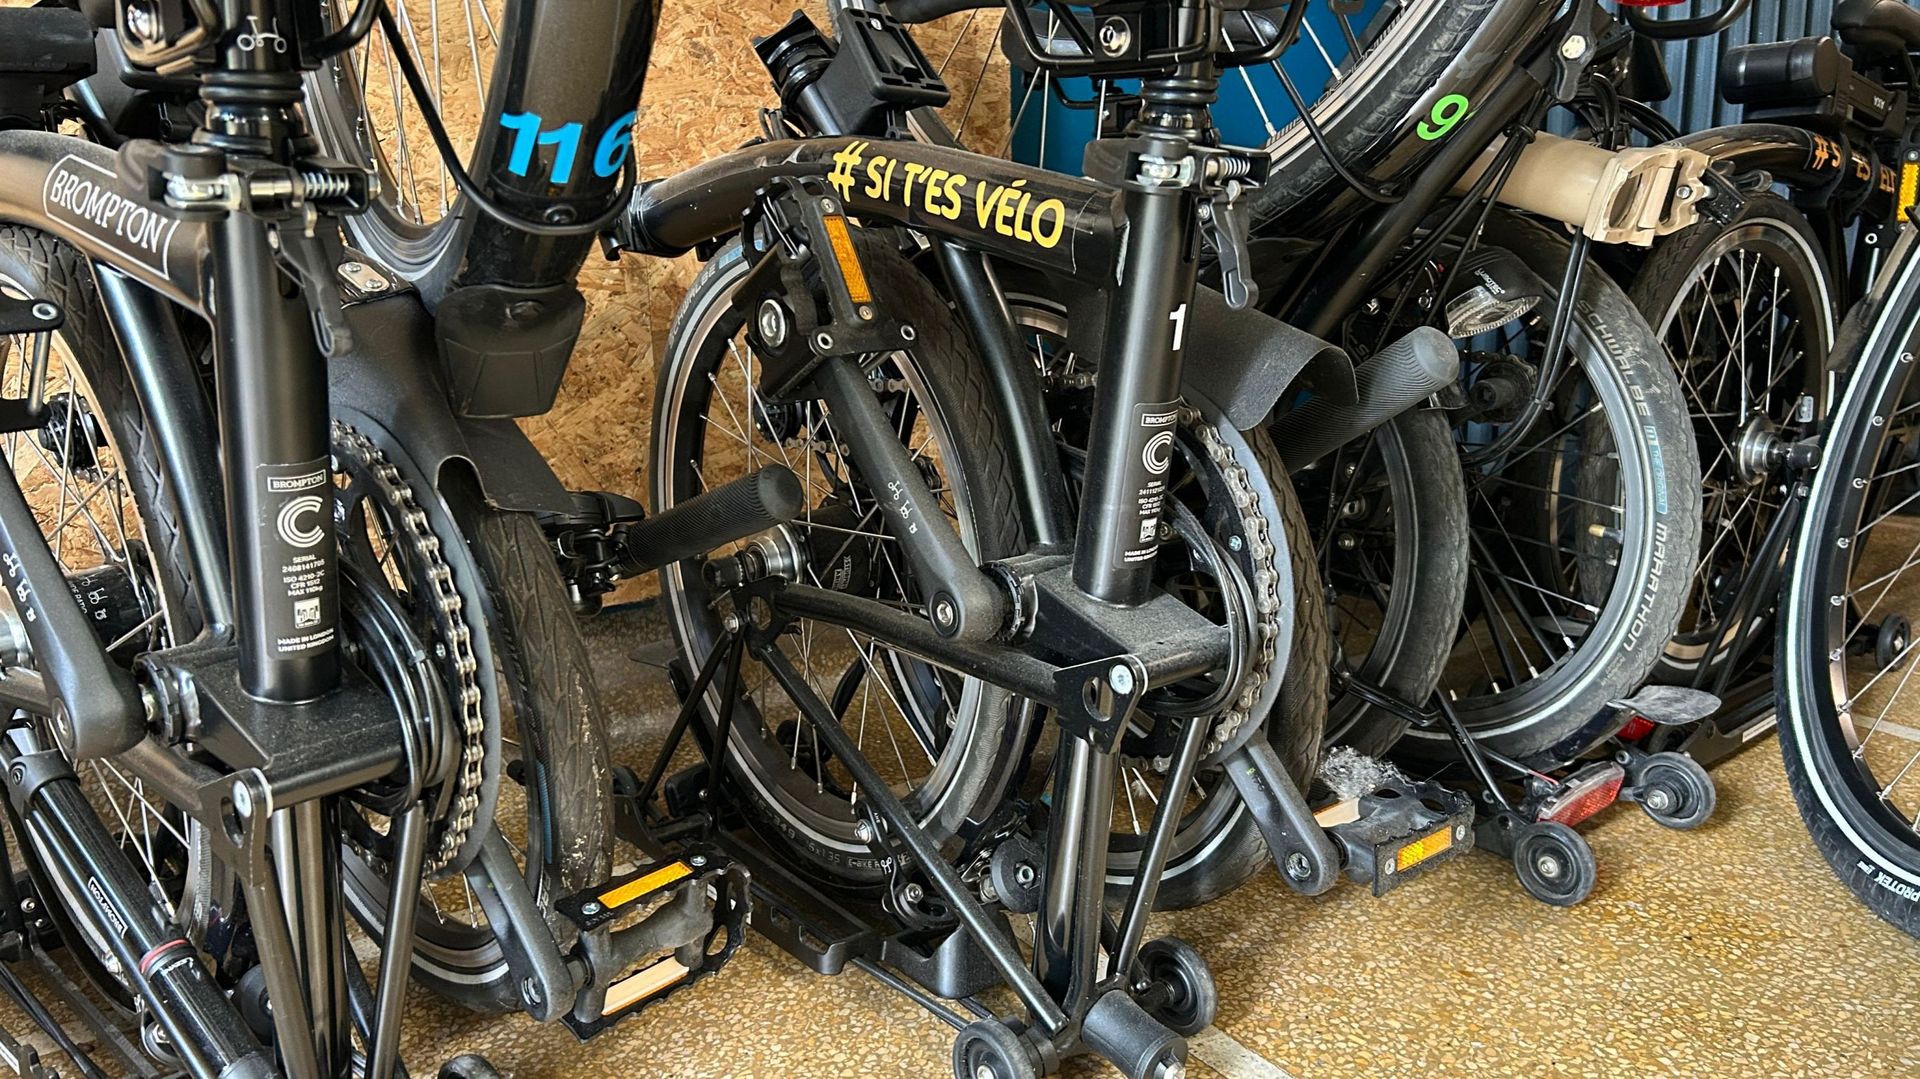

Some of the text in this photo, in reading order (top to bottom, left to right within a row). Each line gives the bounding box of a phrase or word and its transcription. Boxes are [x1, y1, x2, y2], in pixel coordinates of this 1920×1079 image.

[1417, 94, 1469, 140] 9
[500, 111, 637, 184] 116
[50, 169, 169, 253] BROMPTON
[904, 162, 967, 220] T'ES
[976, 179, 1065, 249] VÉLO
[1169, 303, 1187, 351] 1
[1577, 300, 1651, 417] SCHWALBE
[273, 474, 323, 488] BROMPTON
[292, 554, 317, 563] SERIAL
[1622, 521, 1669, 652] MARATHON
[278, 644, 306, 652] UNITED
